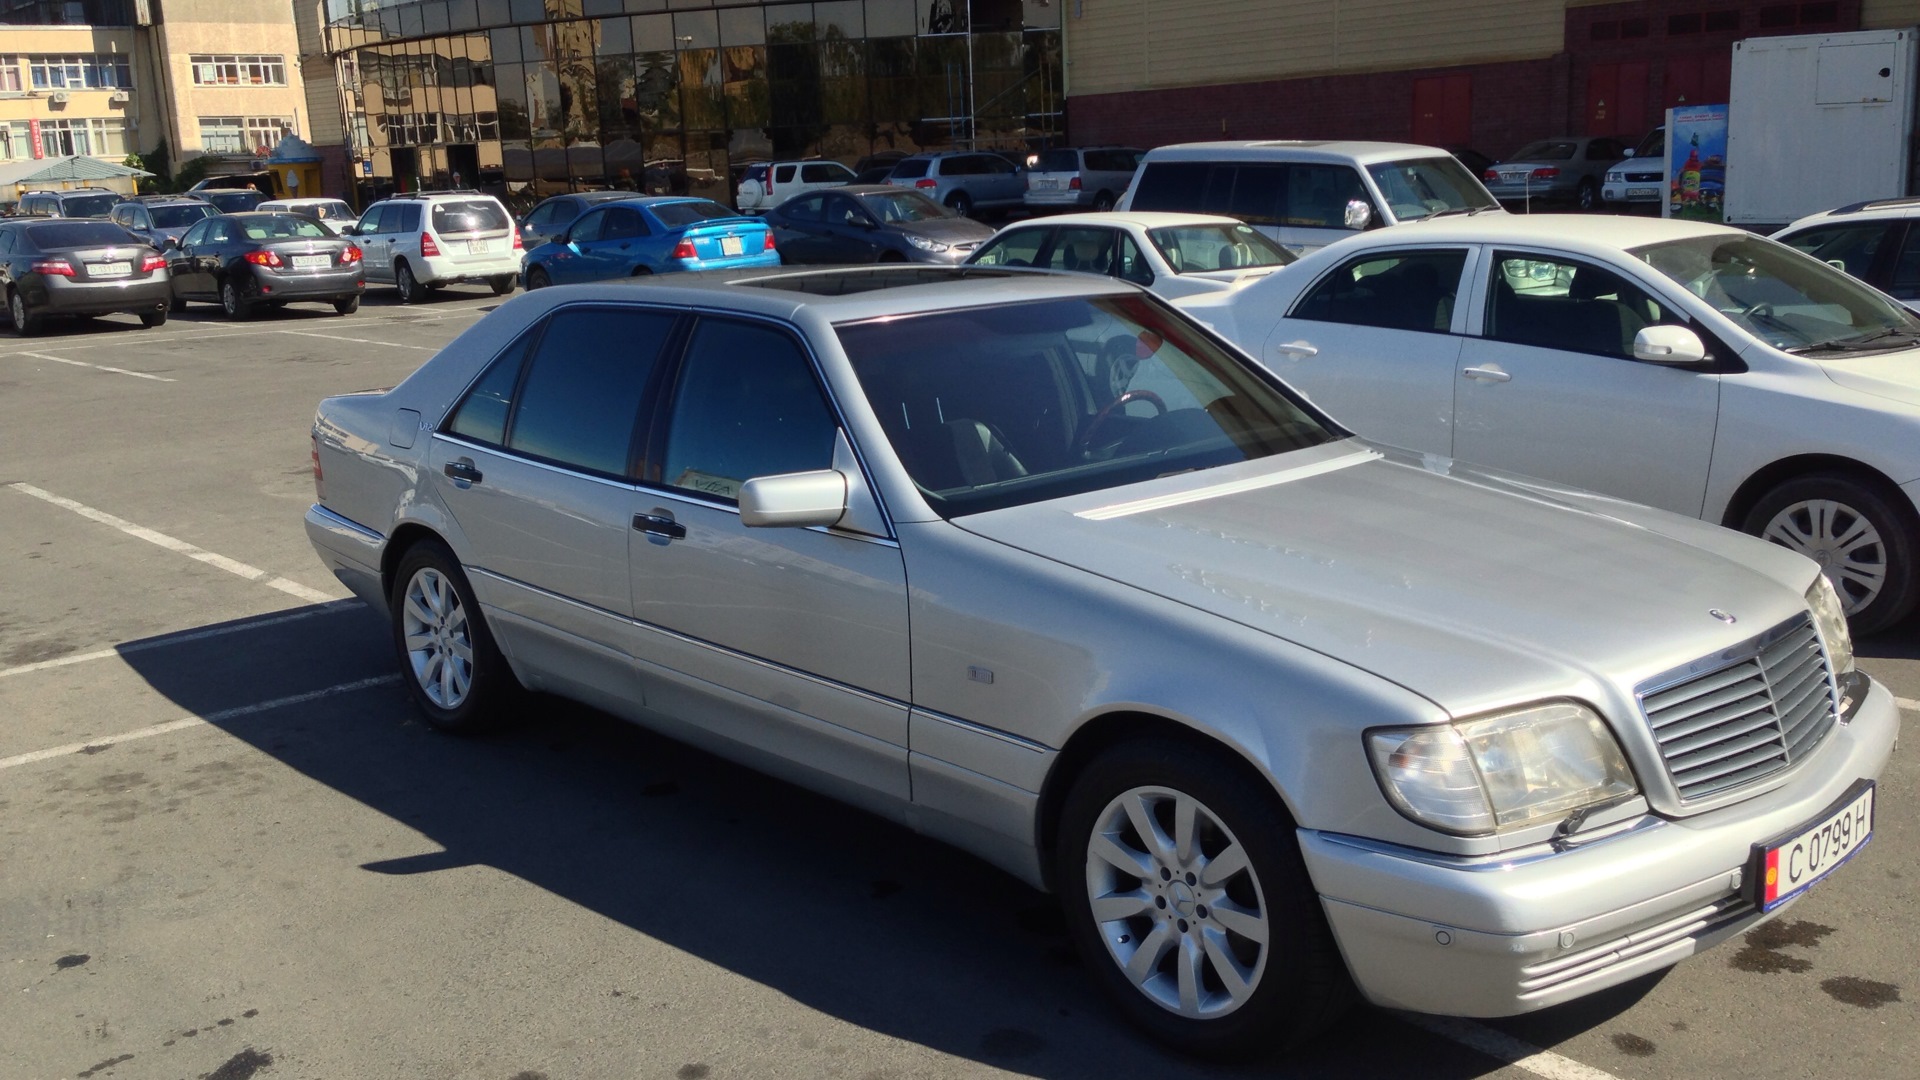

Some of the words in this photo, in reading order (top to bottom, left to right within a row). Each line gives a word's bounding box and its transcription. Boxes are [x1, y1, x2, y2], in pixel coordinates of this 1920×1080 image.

[1789, 843, 1803, 883] C
[1809, 811, 1851, 872] 0799
[1855, 798, 1867, 842] H
